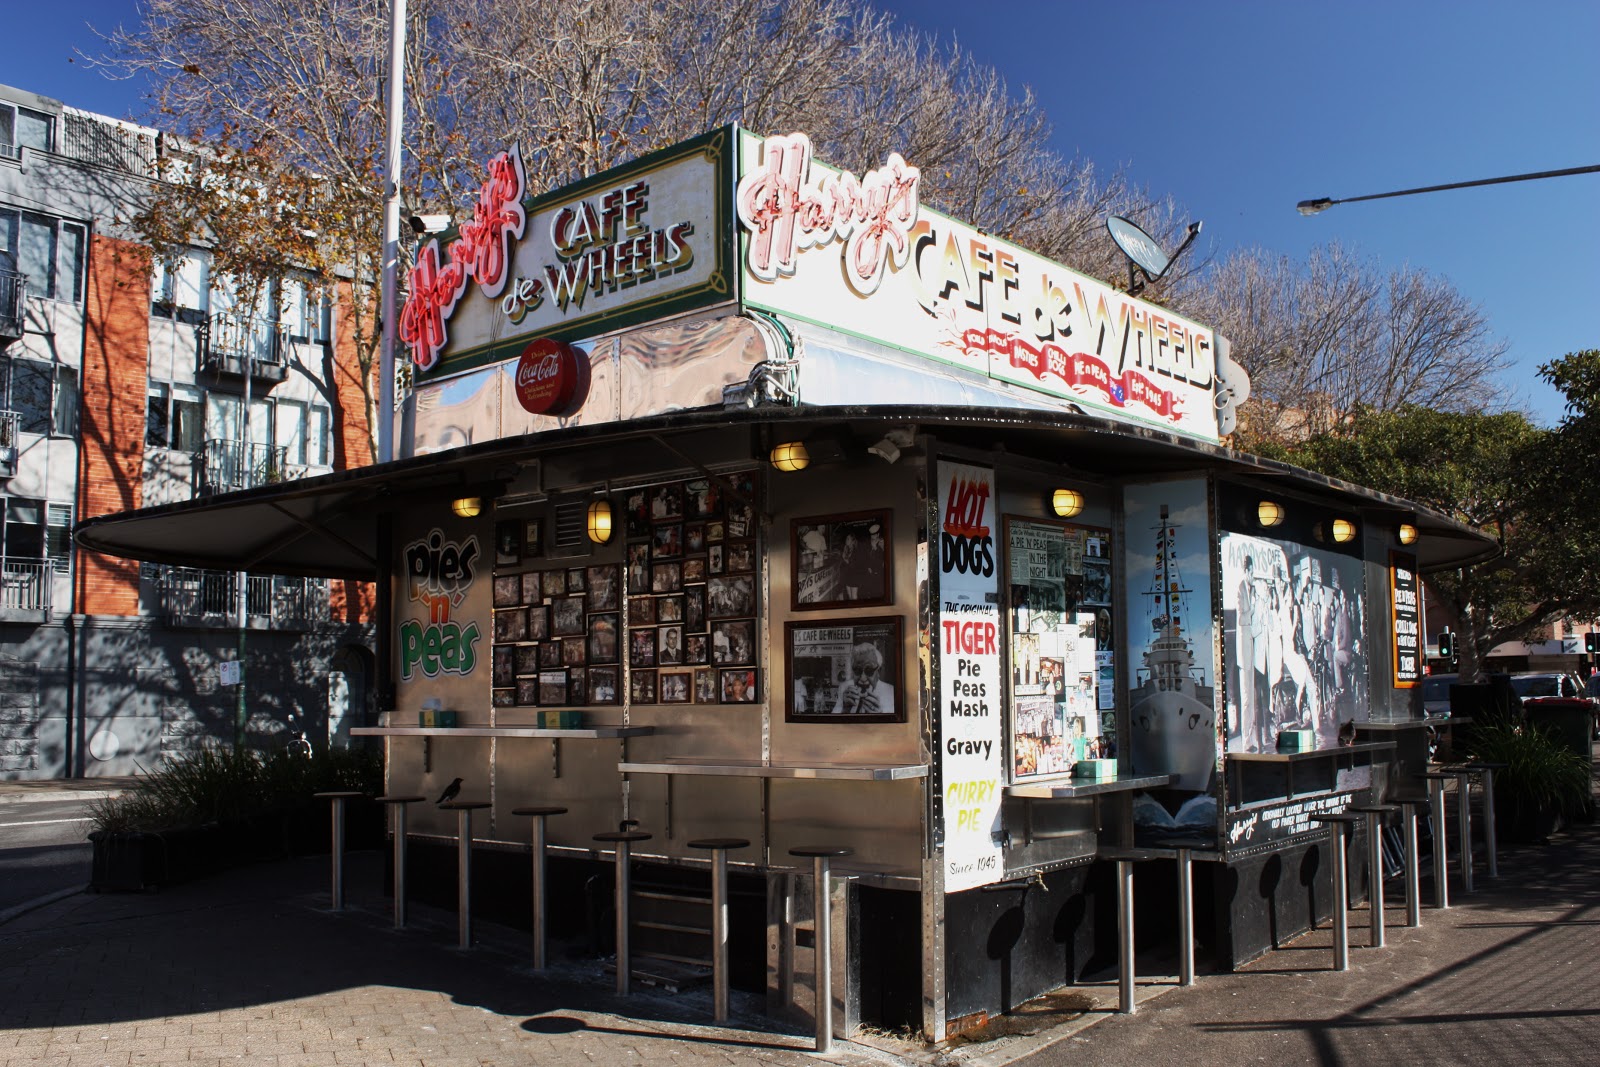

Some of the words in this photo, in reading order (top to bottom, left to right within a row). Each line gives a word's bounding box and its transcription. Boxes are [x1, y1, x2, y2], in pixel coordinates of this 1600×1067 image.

[550, 181, 649, 256] CAFE
[739, 136, 919, 293] Harry's
[400, 150, 523, 370] Harry's
[502, 277, 544, 325] de
[544, 221, 695, 315] WHEELS
[904, 220, 1021, 326] CAFE
[1034, 273, 1073, 342] de
[1073, 281, 1213, 391] WHEELS
[531, 349, 547, 359] Drink
[1013, 345, 1039, 367] PASTIES
[1048, 347, 1067, 366] CHILLI
[1048, 358, 1066, 377] DOGS
[1074, 357, 1086, 376] PIE
[1091, 362, 1108, 386] PEAS
[1145, 385, 1163, 408] 1945
[944, 473, 991, 531] HOT
[941, 531, 994, 578] DOGS
[1010, 537, 1015, 547] A
[1016, 537, 1025, 548] PIE
[1033, 539, 1047, 550] PEAS
[405, 530, 479, 600] pies
[1029, 552, 1036, 562] IN
[1036, 552, 1047, 563] THE
[1267, 548, 1281, 566] CAFE
[1029, 566, 1047, 577] NIGHT
[944, 601, 958, 615] THE
[959, 602, 993, 616] ORIGINAL
[803, 630, 817, 642] CAFE
[942, 620, 996, 655] TIGER
[400, 619, 480, 679] peas
[957, 658, 981, 677] Pie
[953, 679, 986, 698] Peas
[950, 699, 989, 717] Mash
[946, 737, 992, 761] Gravy
[947, 778, 996, 808] CURRY
[957, 808, 982, 833] PIE
[977, 855, 996, 871] 1945
